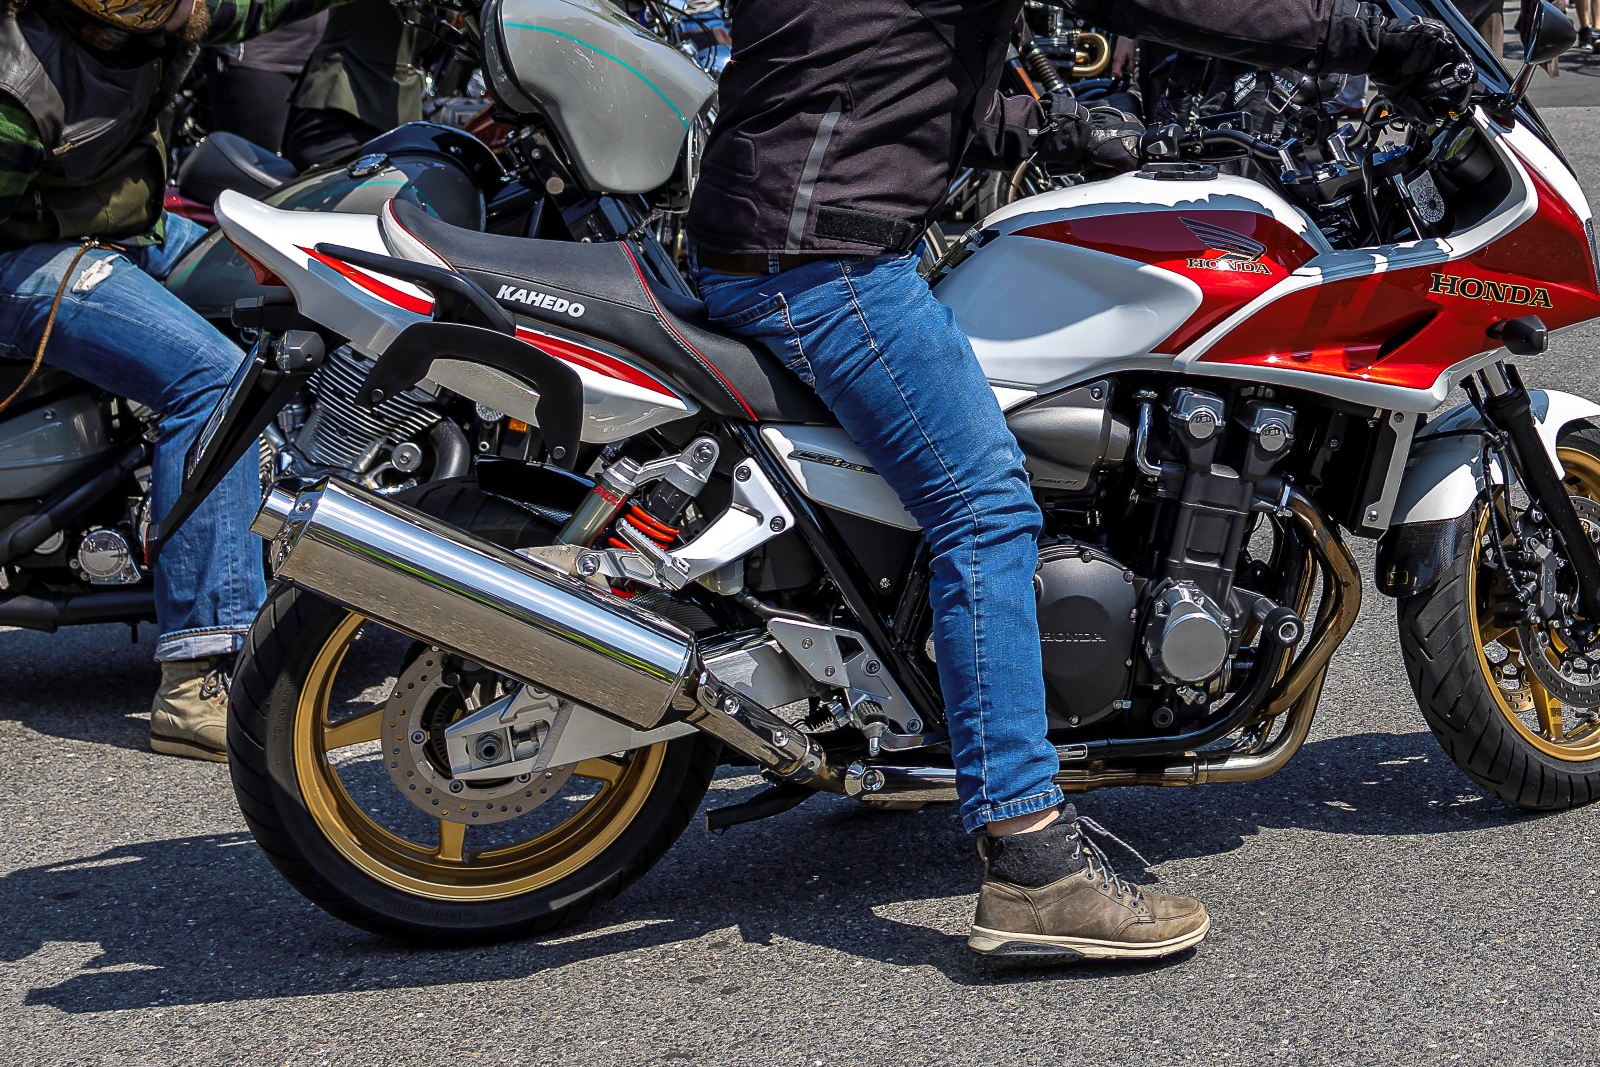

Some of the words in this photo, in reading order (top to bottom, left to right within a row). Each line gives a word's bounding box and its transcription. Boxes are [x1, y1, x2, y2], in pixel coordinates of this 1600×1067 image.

[1186, 258, 1272, 275] HONDA
[496, 284, 585, 318] KAHEDO
[1429, 272, 1553, 309] HONDA
[1040, 633, 1106, 643] HONDA
